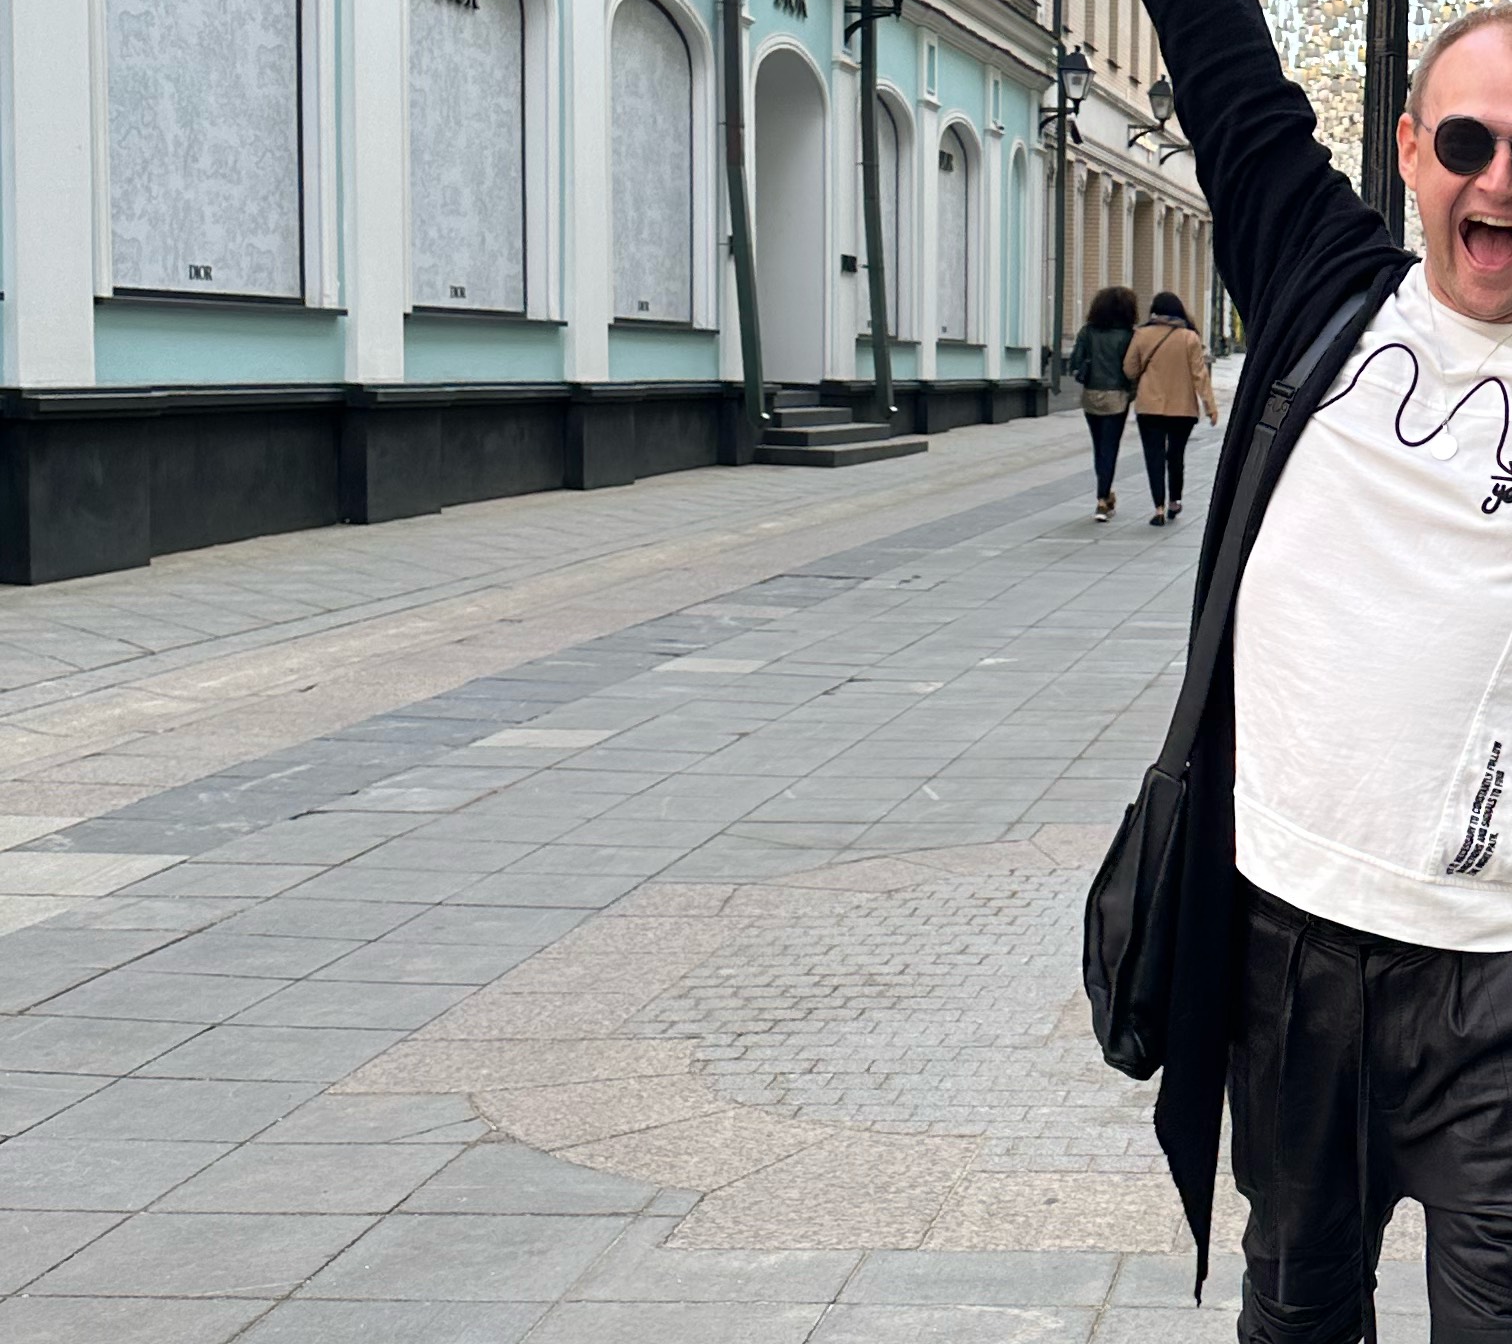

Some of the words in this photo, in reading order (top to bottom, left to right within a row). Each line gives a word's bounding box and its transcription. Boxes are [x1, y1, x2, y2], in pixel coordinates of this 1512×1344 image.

[189, 264, 212, 281] DIOR
[1470, 815, 1479, 825] TO
[1486, 741, 1502, 771] FOLLOW
[1490, 788, 1502, 797] TO
